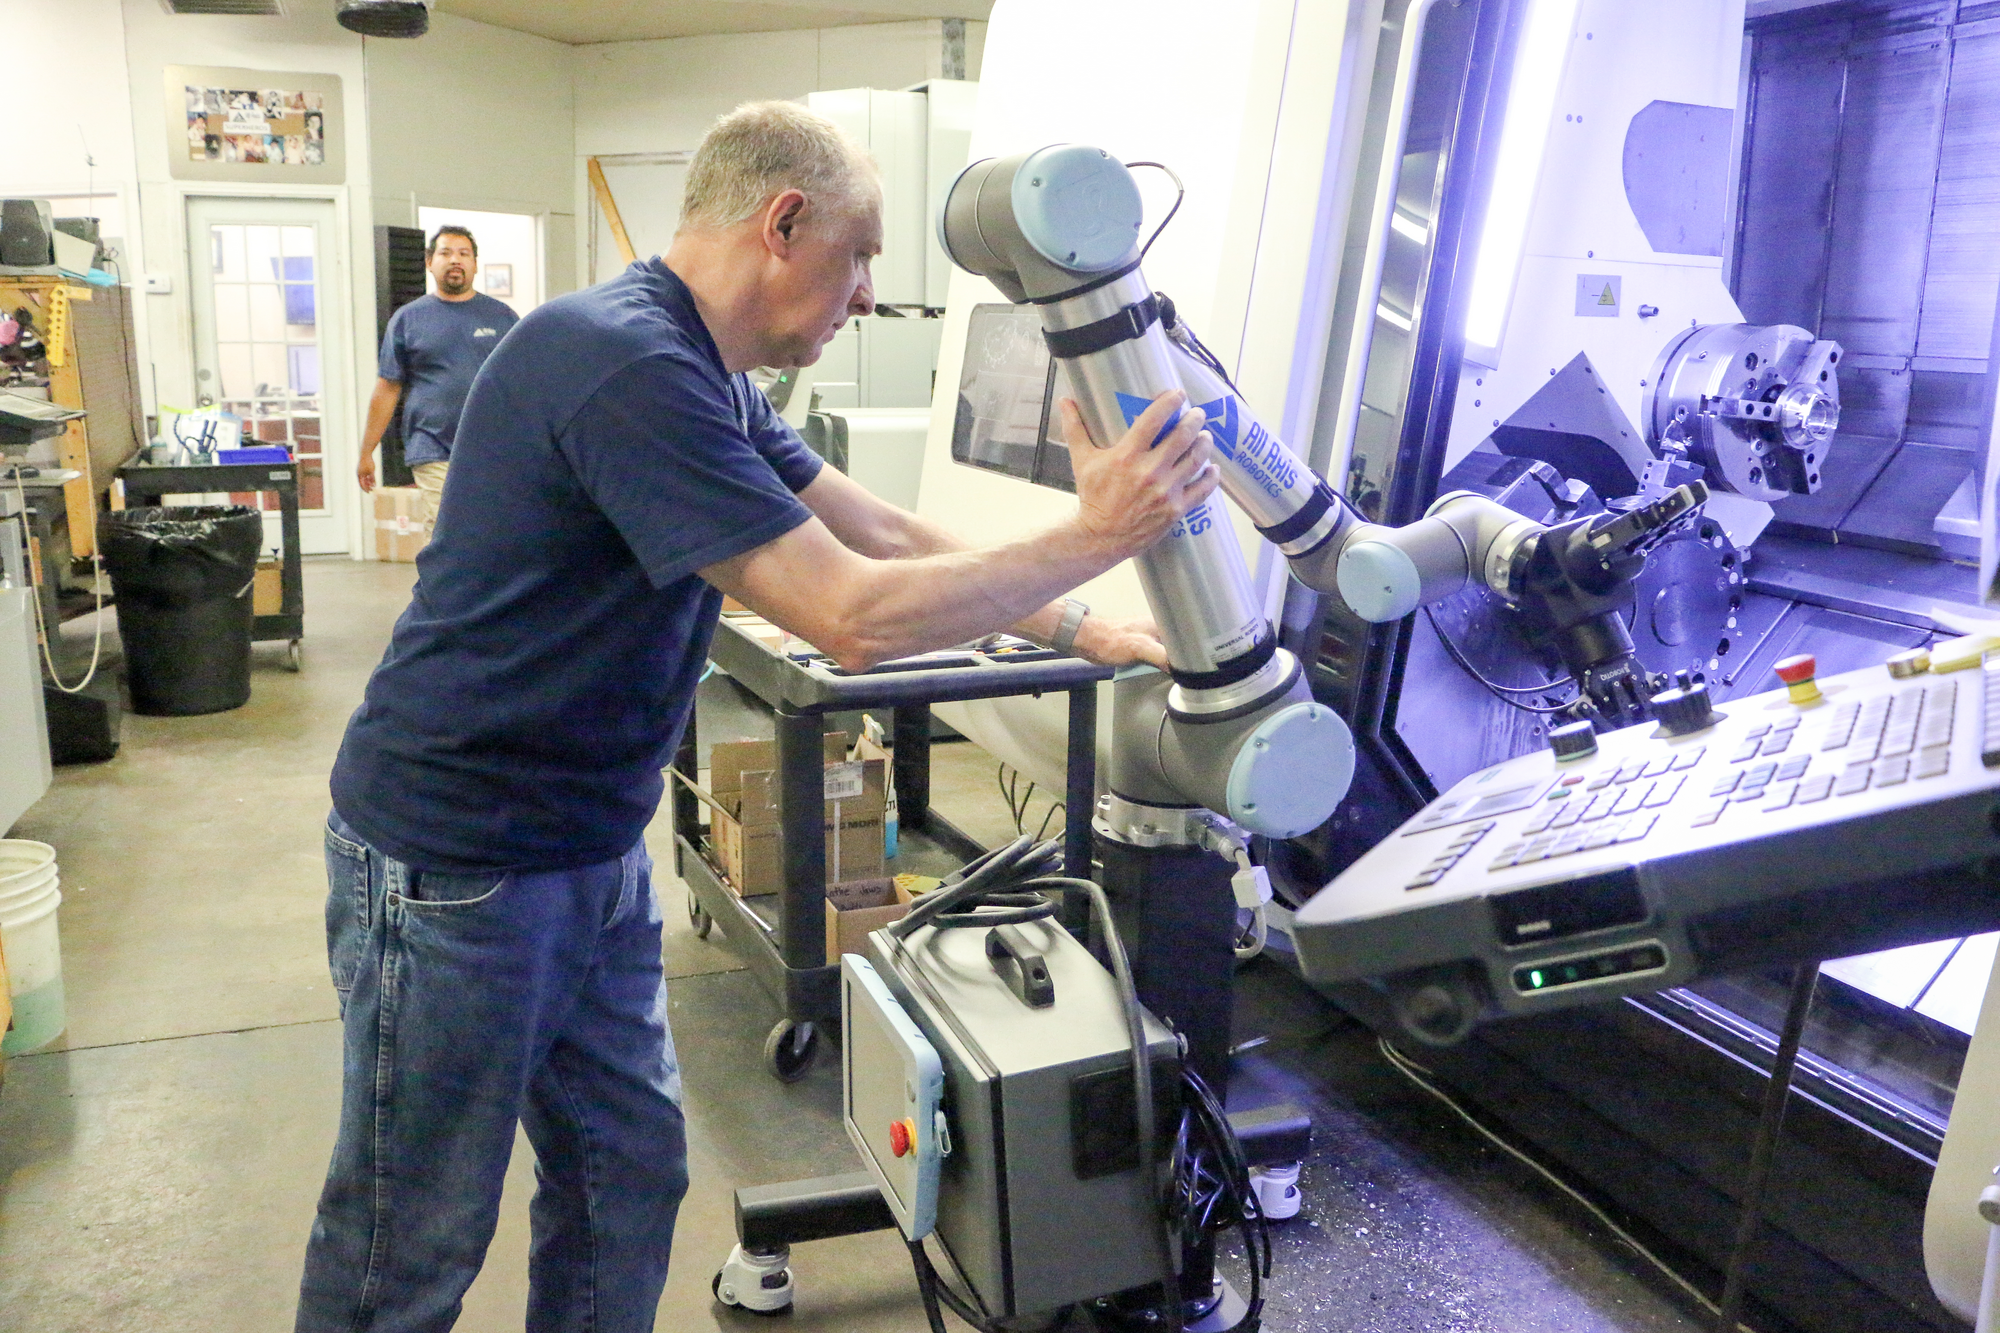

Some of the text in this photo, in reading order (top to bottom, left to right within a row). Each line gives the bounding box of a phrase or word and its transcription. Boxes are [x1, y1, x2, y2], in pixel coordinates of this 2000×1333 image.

[1242, 421, 1268, 458] All
[1235, 451, 1282, 498] ROBOTICS
[1214, 635, 1244, 651] UNIVERSAL
[848, 818, 879, 829] MORI
